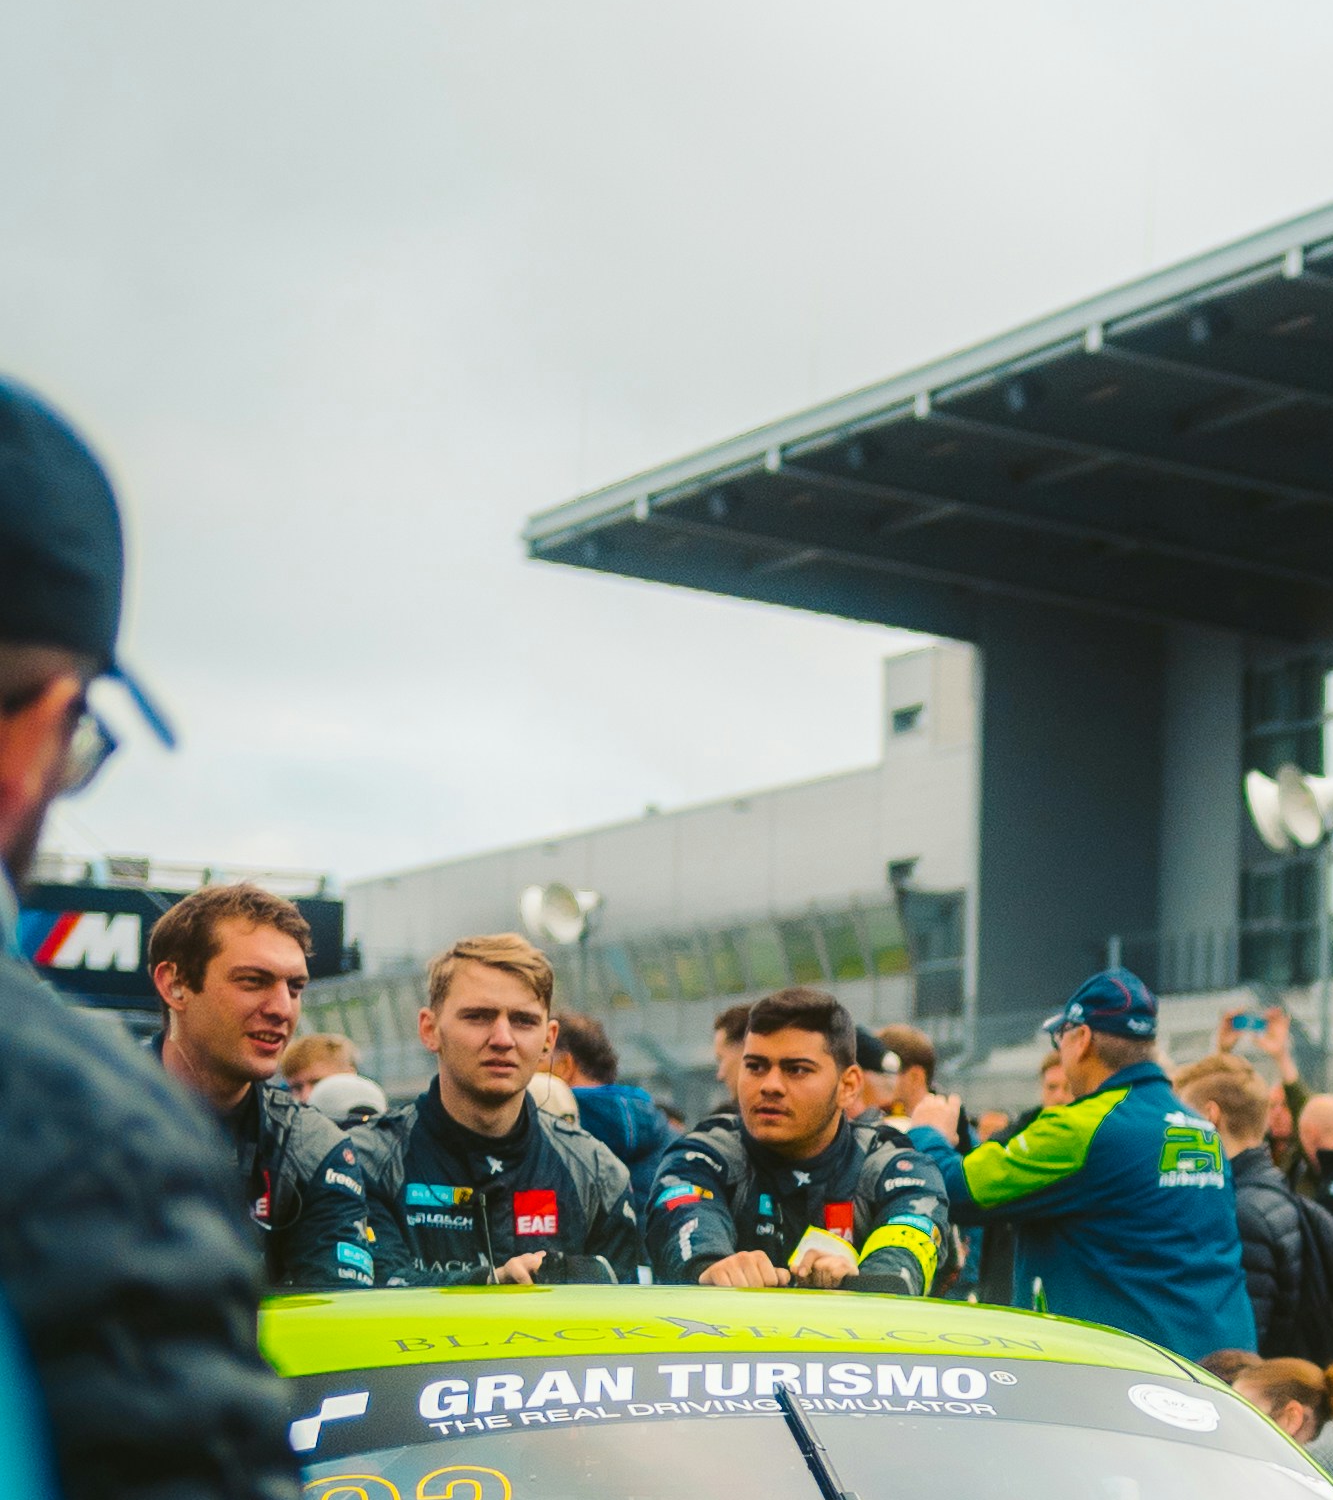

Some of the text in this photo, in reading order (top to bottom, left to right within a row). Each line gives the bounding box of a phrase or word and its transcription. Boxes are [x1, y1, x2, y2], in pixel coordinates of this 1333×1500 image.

[517, 1214, 557, 1234] EAE
[394, 1325, 1045, 1352] BLACK FALCON
[418, 1361, 988, 1420] GRAN TURISMO
[429, 1398, 998, 1436] THE REAL DRIVING SIMULATOR
